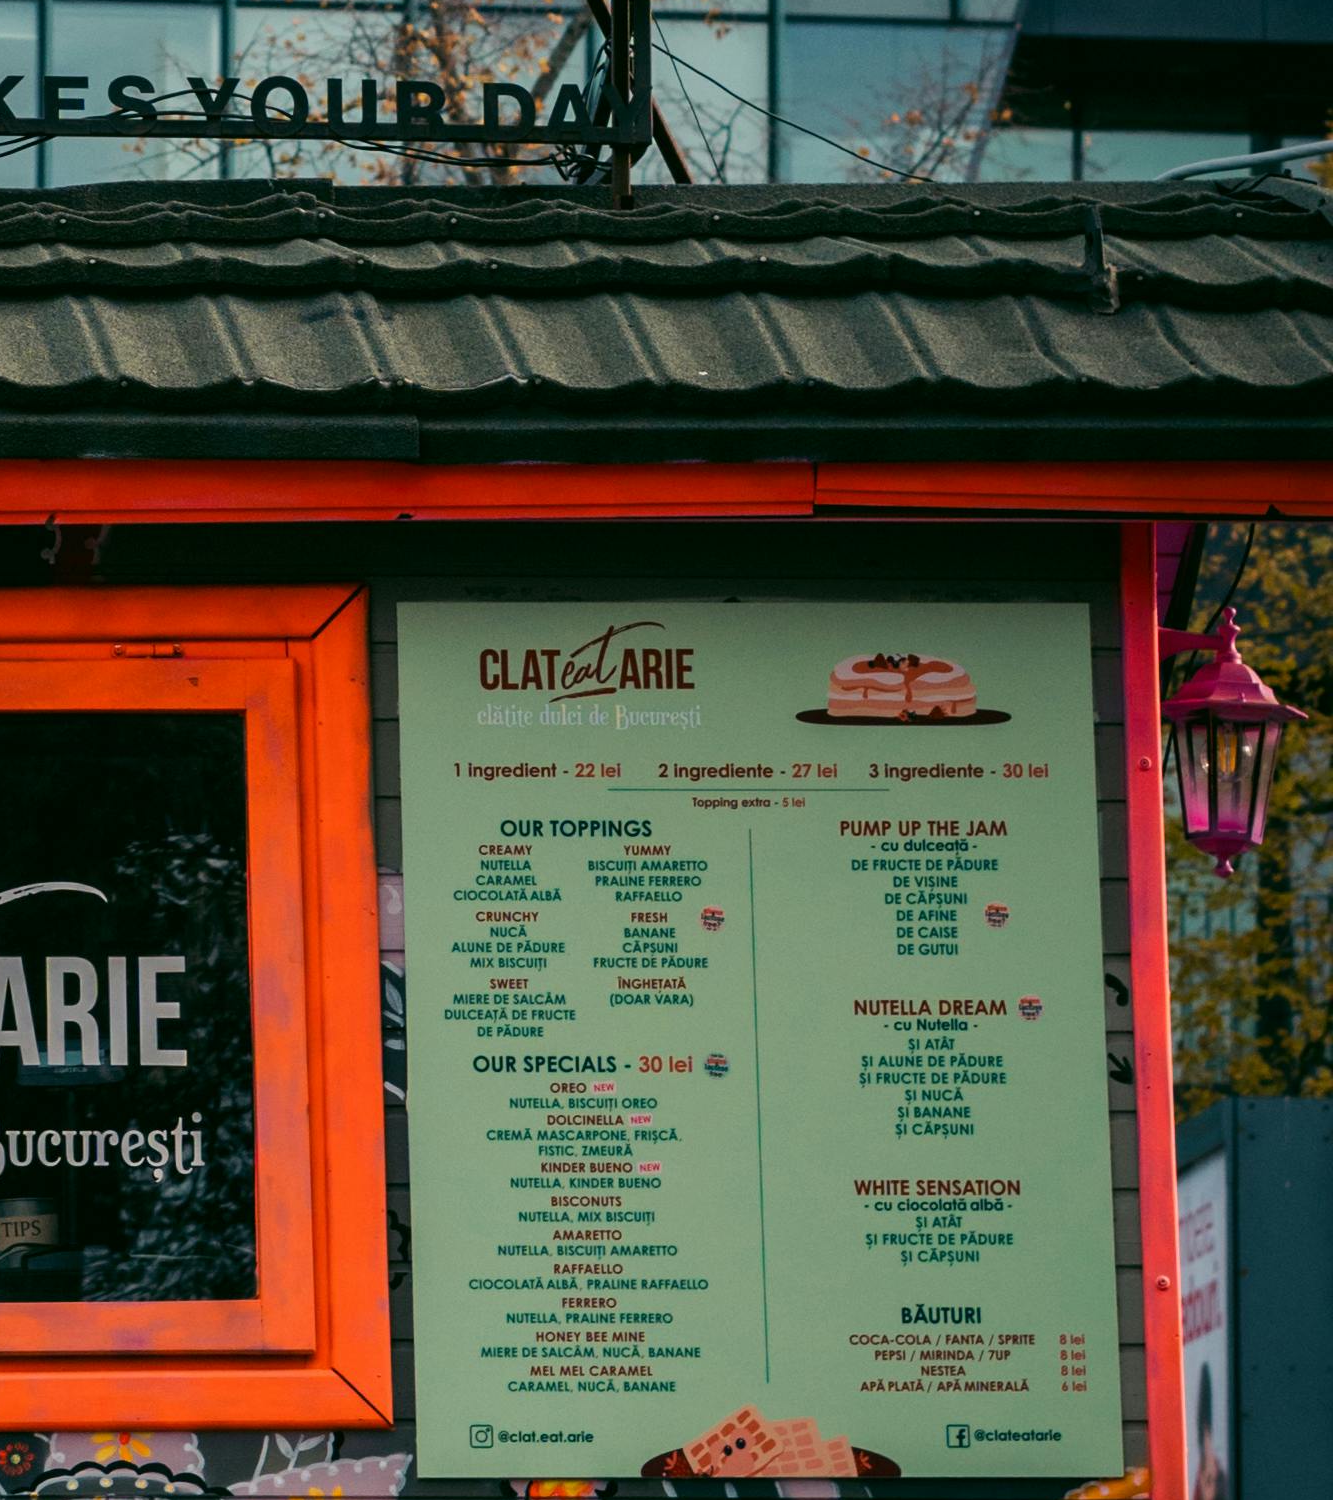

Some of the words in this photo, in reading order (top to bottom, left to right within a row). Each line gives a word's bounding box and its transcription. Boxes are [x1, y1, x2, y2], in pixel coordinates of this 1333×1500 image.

[187, 76, 446, 138] YOUR
[540, 704, 584, 725] dulci
[589, 704, 609, 725] de
[454, 763, 460, 777] 1
[469, 763, 557, 781] ingredient
[575, 763, 595, 777] 22
[601, 763, 620, 777] lei
[659, 764, 668, 777] 2
[674, 763, 773, 781] ingrediente
[792, 764, 812, 778] 27
[818, 764, 837, 778] lei
[869, 764, 879, 778] 3
[885, 763, 984, 781] ingrediente
[1003, 763, 1023, 778] 30
[1029, 764, 1048, 778] lei
[692, 797, 738, 809] Topping
[741, 798, 771, 807] extra
[783, 798, 789, 807] 5
[792, 798, 805, 807] lei
[501, 820, 543, 837] OUR
[550, 820, 652, 837] TOPPINGS
[840, 821, 891, 836] PUMP
[899, 821, 921, 836] UP
[927, 821, 959, 836] THE
[966, 821, 1007, 836] JAM
[479, 845, 532, 855] CREAMY
[624, 845, 671, 855] YUMMY
[881, 842, 898, 851] cu
[481, 860, 531, 871] NUTELLA
[641, 860, 708, 871] AMARETTO
[476, 875, 537, 886] CARAMEL
[595, 876, 645, 886] PRALINE
[649, 876, 701, 886] FERRERO
[616, 891, 682, 902] RAFFAELLO
[476, 912, 538, 922] CRUNCHY
[631, 912, 667, 923] FRESH
[897, 910, 913, 921] DE
[918, 910, 957, 921] AFINE
[624, 928, 675, 938] BANANE
[897, 927, 913, 938] DE
[918, 927, 957, 938] CAISE
[897, 944, 914, 955] DE
[918, 944, 958, 955] GUTUI
[490, 979, 528, 989] SWEET
[854, 1000, 932, 1015] NUTELLA
[939, 1000, 1007, 1015] DREAM
[894, 1021, 911, 1031] cu
[917, 1018, 968, 1031] Nutella
[473, 1056, 516, 1072] OUR
[524, 1056, 616, 1073] SPECIALS
[639, 1056, 662, 1073] 30
[669, 1056, 692, 1072] lei
[550, 1083, 587, 1093] OREO
[593, 1083, 614, 1092] NEW
[547, 1115, 623, 1125] DOLCINELLA
[630, 1115, 651, 1124] NEW
[541, 1162, 585, 1173] KINDER
[590, 1162, 633, 1173] BUENO
[639, 1163, 660, 1173] NEW
[854, 1180, 909, 1195] WHITE
[916, 1180, 1020, 1196] SENSATION
[551, 1196, 621, 1207] BISCONUTS
[1, 1220, 41, 1237] TIPS
[553, 1230, 622, 1240] AMARETTO
[554, 1264, 623, 1274] RAFFAELLO
[562, 1298, 617, 1308] FERRERO
[902, 1304, 981, 1324] BĂUTURI
[536, 1332, 581, 1342] HONEY
[586, 1332, 607, 1342] BEE
[612, 1332, 645, 1342] MINE
[849, 1334, 931, 1345] COCA-COLA
[946, 1334, 984, 1345] FANTA
[998, 1334, 1035, 1345] SPRITE
[1060, 1334, 1067, 1345] 8
[1070, 1334, 1085, 1345] lei
[875, 1350, 905, 1360] PEPSI
[920, 1350, 974, 1360] MIRINDA
[988, 1350, 1011, 1360] 7UP
[1060, 1350, 1068, 1360] 8
[1071, 1350, 1086, 1360] lei
[530, 1366, 555, 1376] MEL
[560, 1366, 585, 1376] MEL
[589, 1366, 653, 1376] CARAMEL
[921, 1365, 966, 1376] NESTEA
[1061, 1365, 1068, 1376] 8
[1072, 1365, 1086, 1376] lei
[497, 1430, 594, 1446] @clat.eat.arie
[974, 1430, 1062, 1442] @clateatarie
